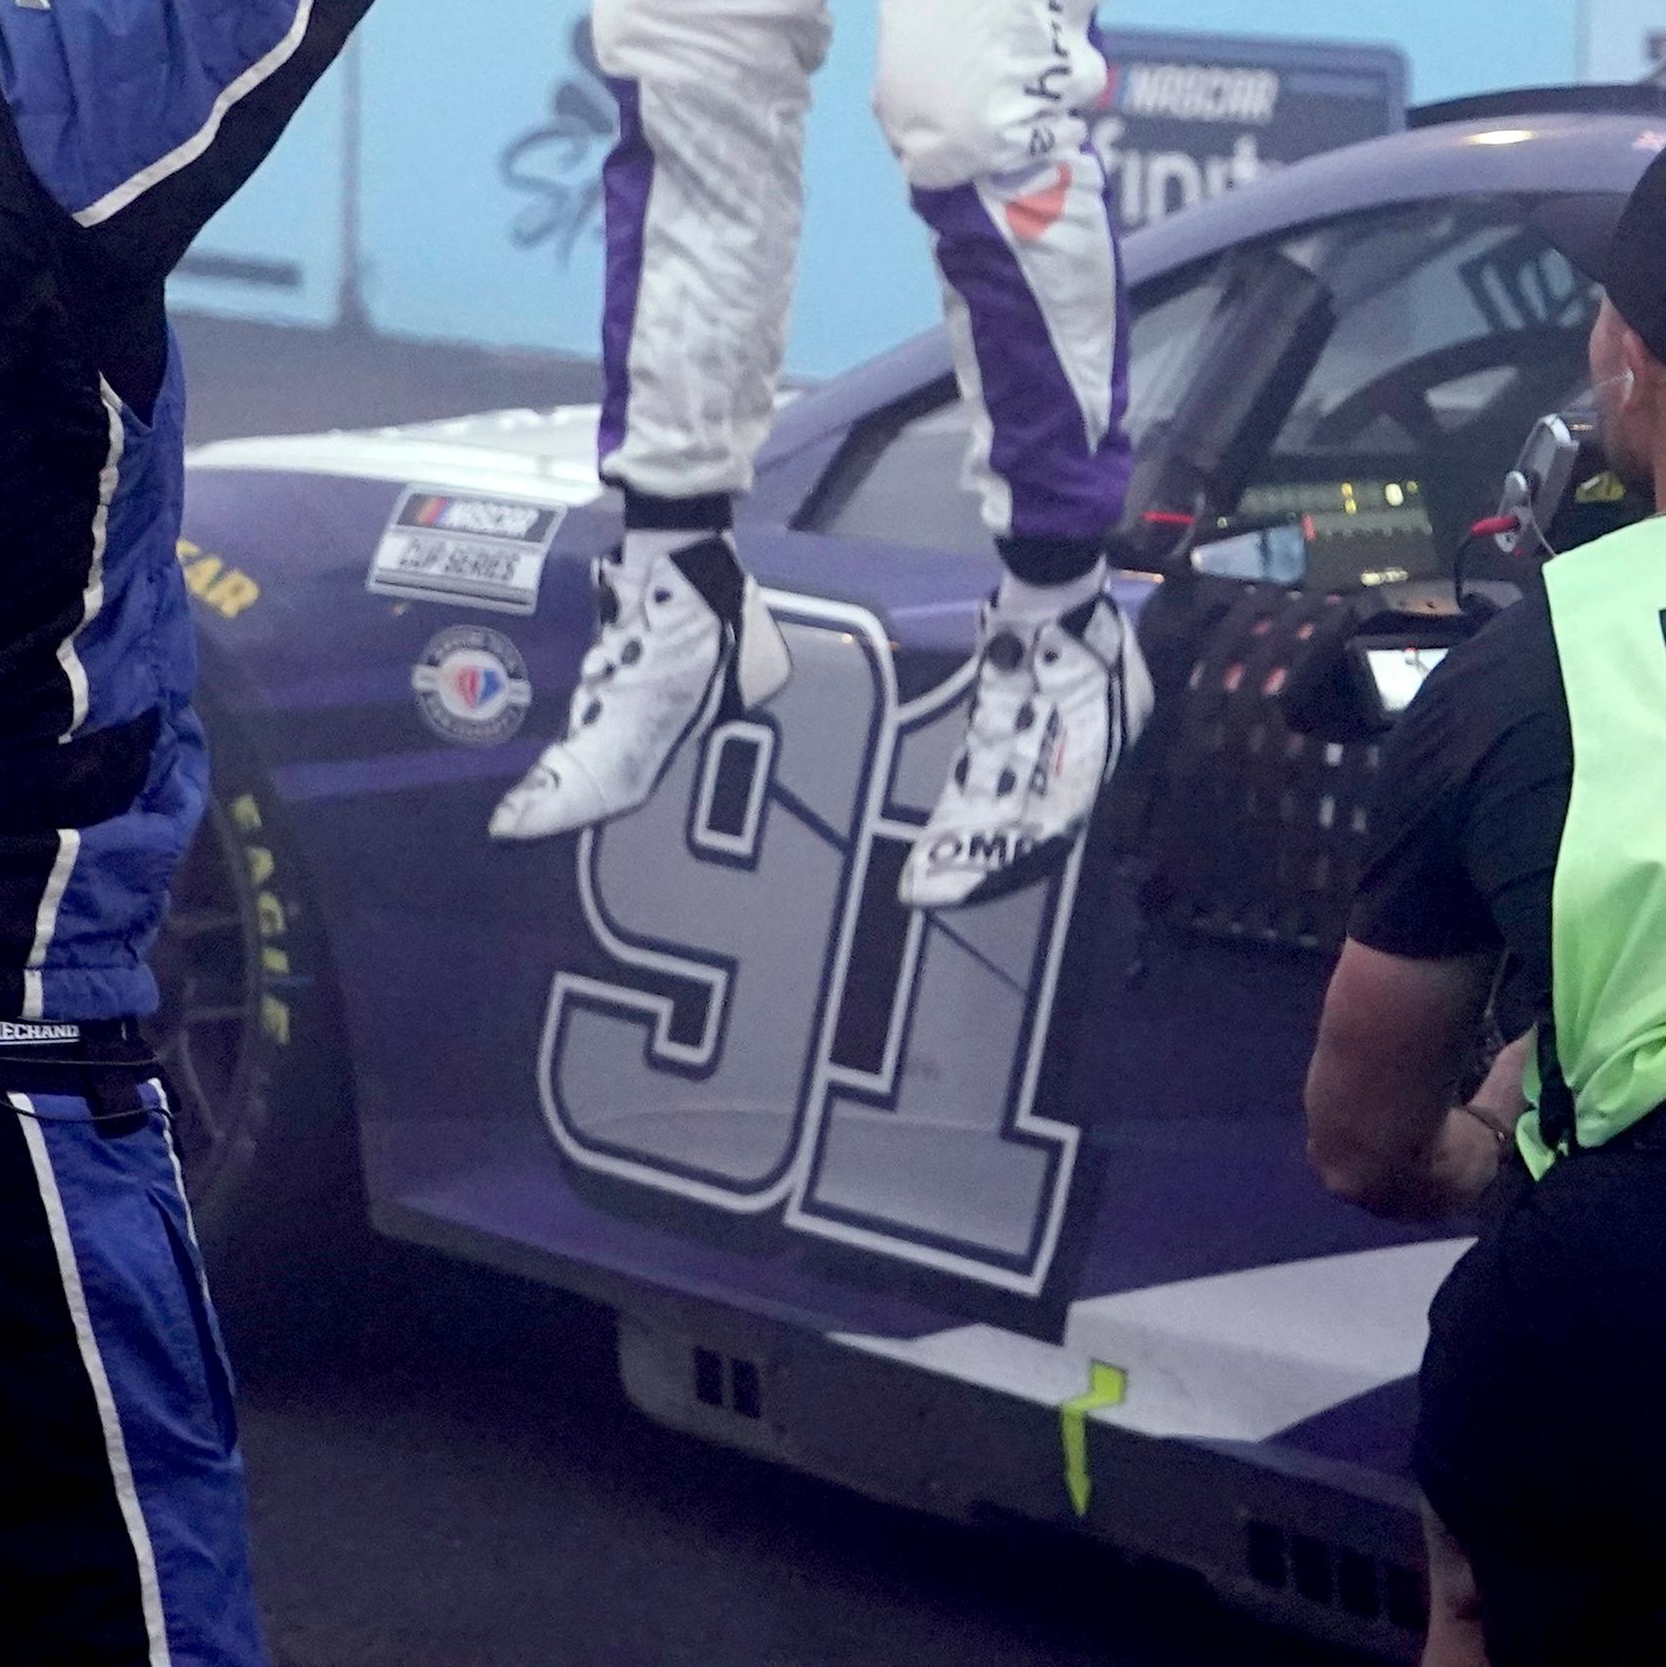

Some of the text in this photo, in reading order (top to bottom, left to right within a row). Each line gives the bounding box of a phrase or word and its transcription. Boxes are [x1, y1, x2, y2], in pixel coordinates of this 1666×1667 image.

[442, 500, 541, 538] NASCAR
[400, 537, 519, 582] CUP SERIES
[538, 584, 1081, 1297] 91
